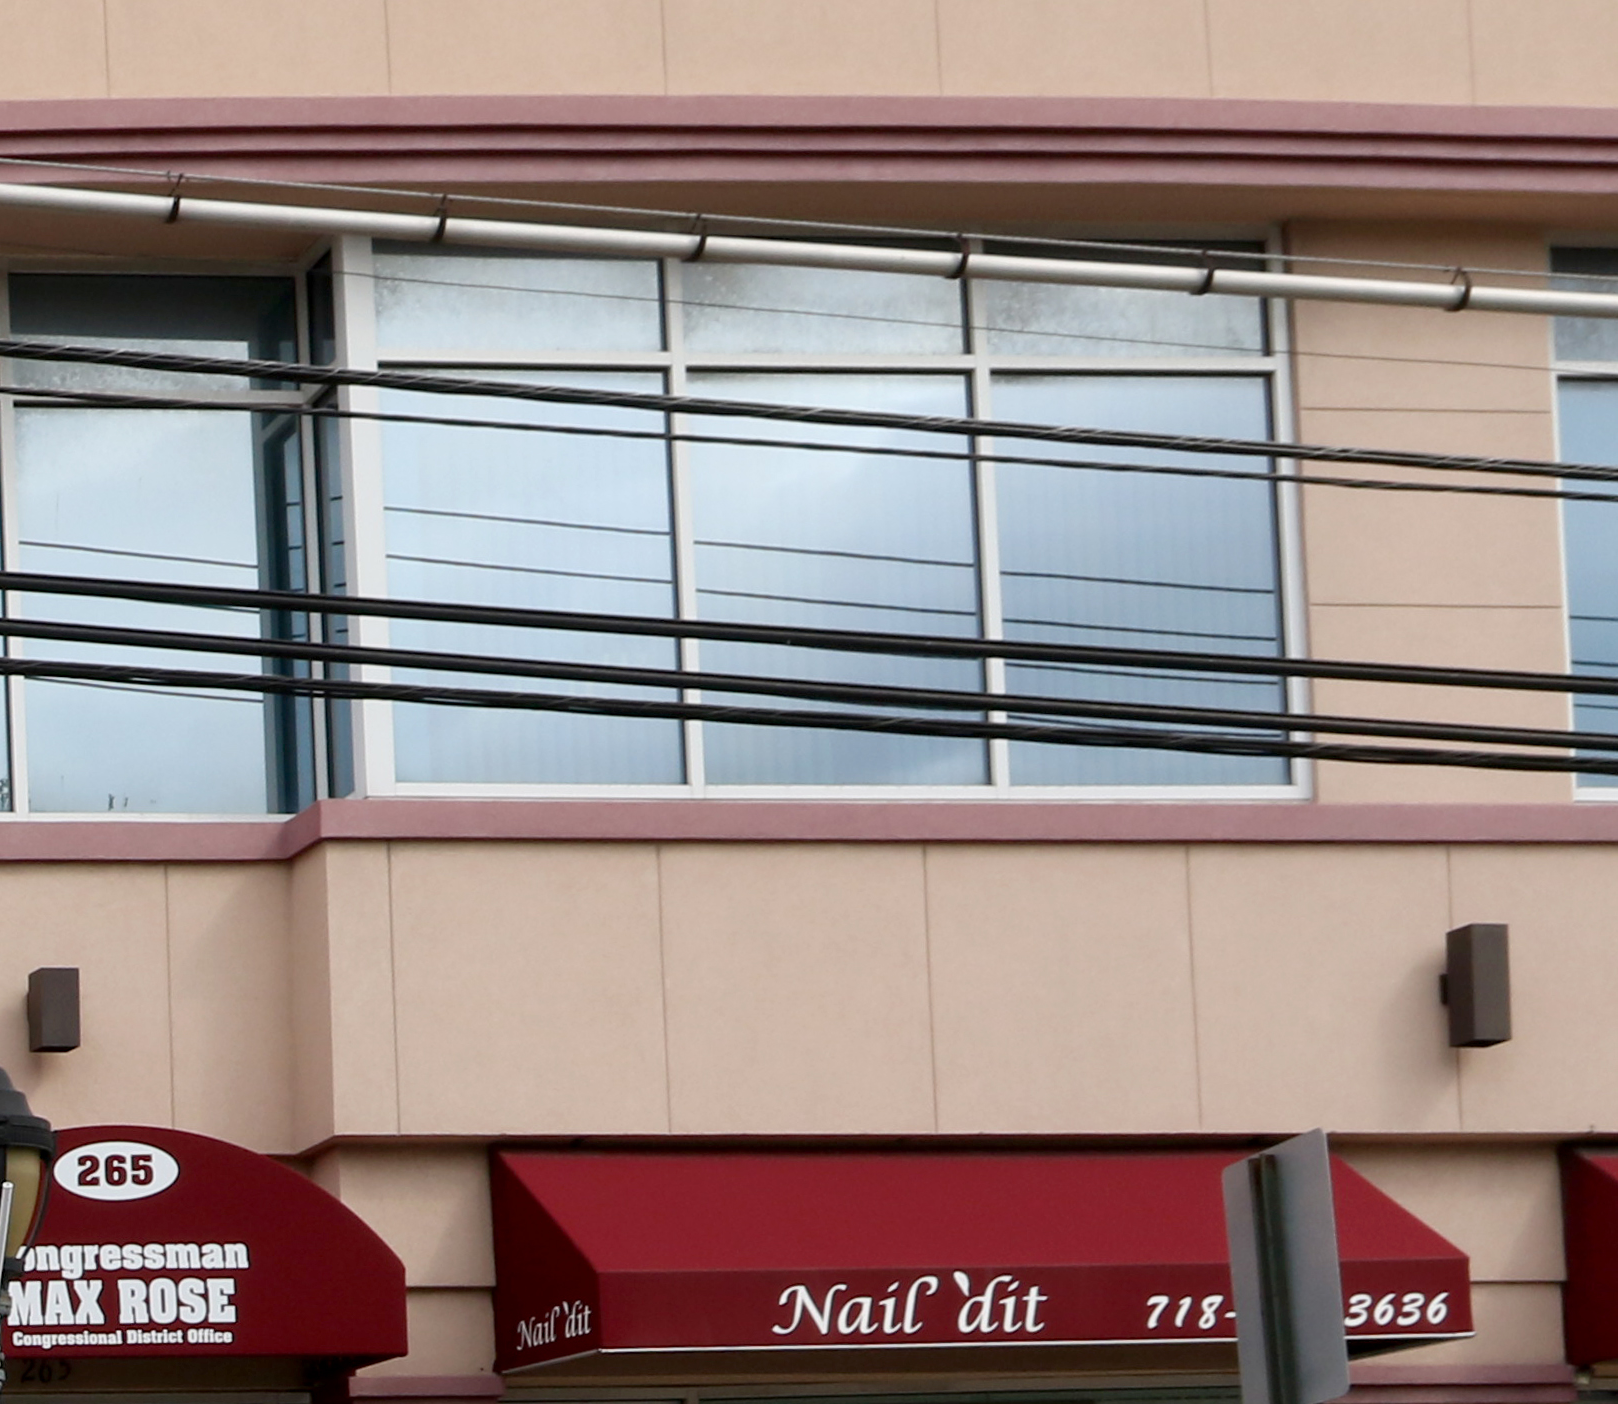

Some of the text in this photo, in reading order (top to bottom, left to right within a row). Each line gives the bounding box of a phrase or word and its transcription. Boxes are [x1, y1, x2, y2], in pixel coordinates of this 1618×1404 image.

[76, 1154, 154, 1187] 265
[16, 1241, 250, 1280] ongressman
[7, 1277, 238, 1326] MAX ROSE
[772, 1275, 939, 1336] Nail
[13, 1328, 233, 1350] Congressional District Office
[516, 1308, 560, 1352] Nail
